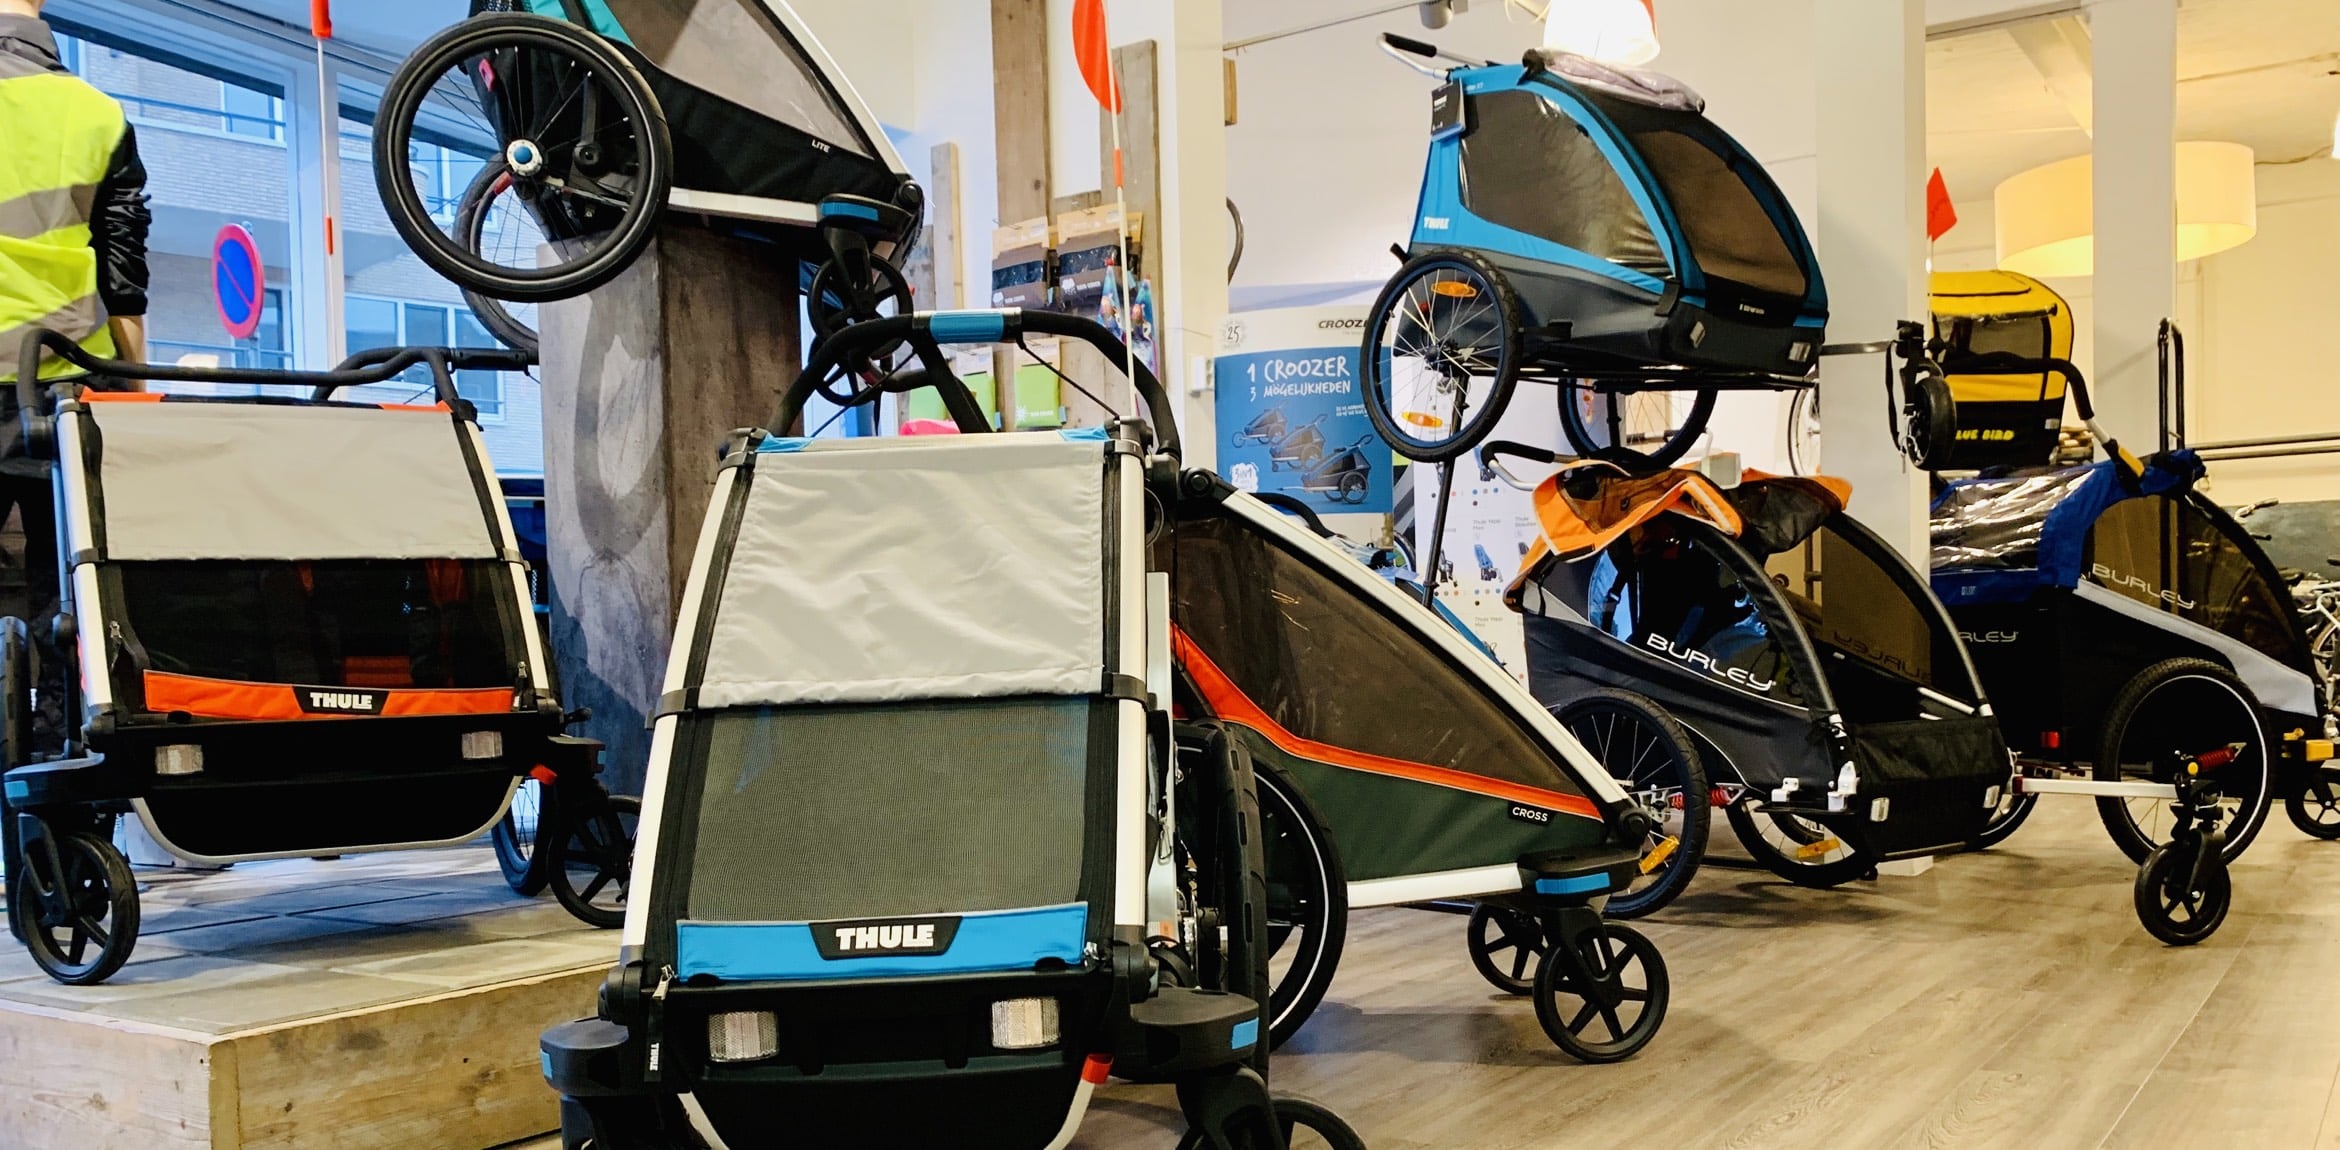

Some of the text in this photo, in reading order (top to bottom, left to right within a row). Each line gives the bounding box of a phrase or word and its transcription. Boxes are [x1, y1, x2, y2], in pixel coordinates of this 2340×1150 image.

[811, 139, 831, 153] LITE
[1228, 325, 1240, 343] 25
[1247, 355, 1350, 383] 1 CROOZER
[1250, 386, 1257, 402] 3
[1955, 429, 2015, 441] LUE BIRD
[2092, 563, 2195, 609] BURLEY
[1958, 631, 2018, 643] RLEY
[1646, 632, 1774, 692] BURLEY
[310, 692, 373, 710] THULE
[1512, 806, 1548, 822] CROSS
[836, 924, 935, 950] THULE
